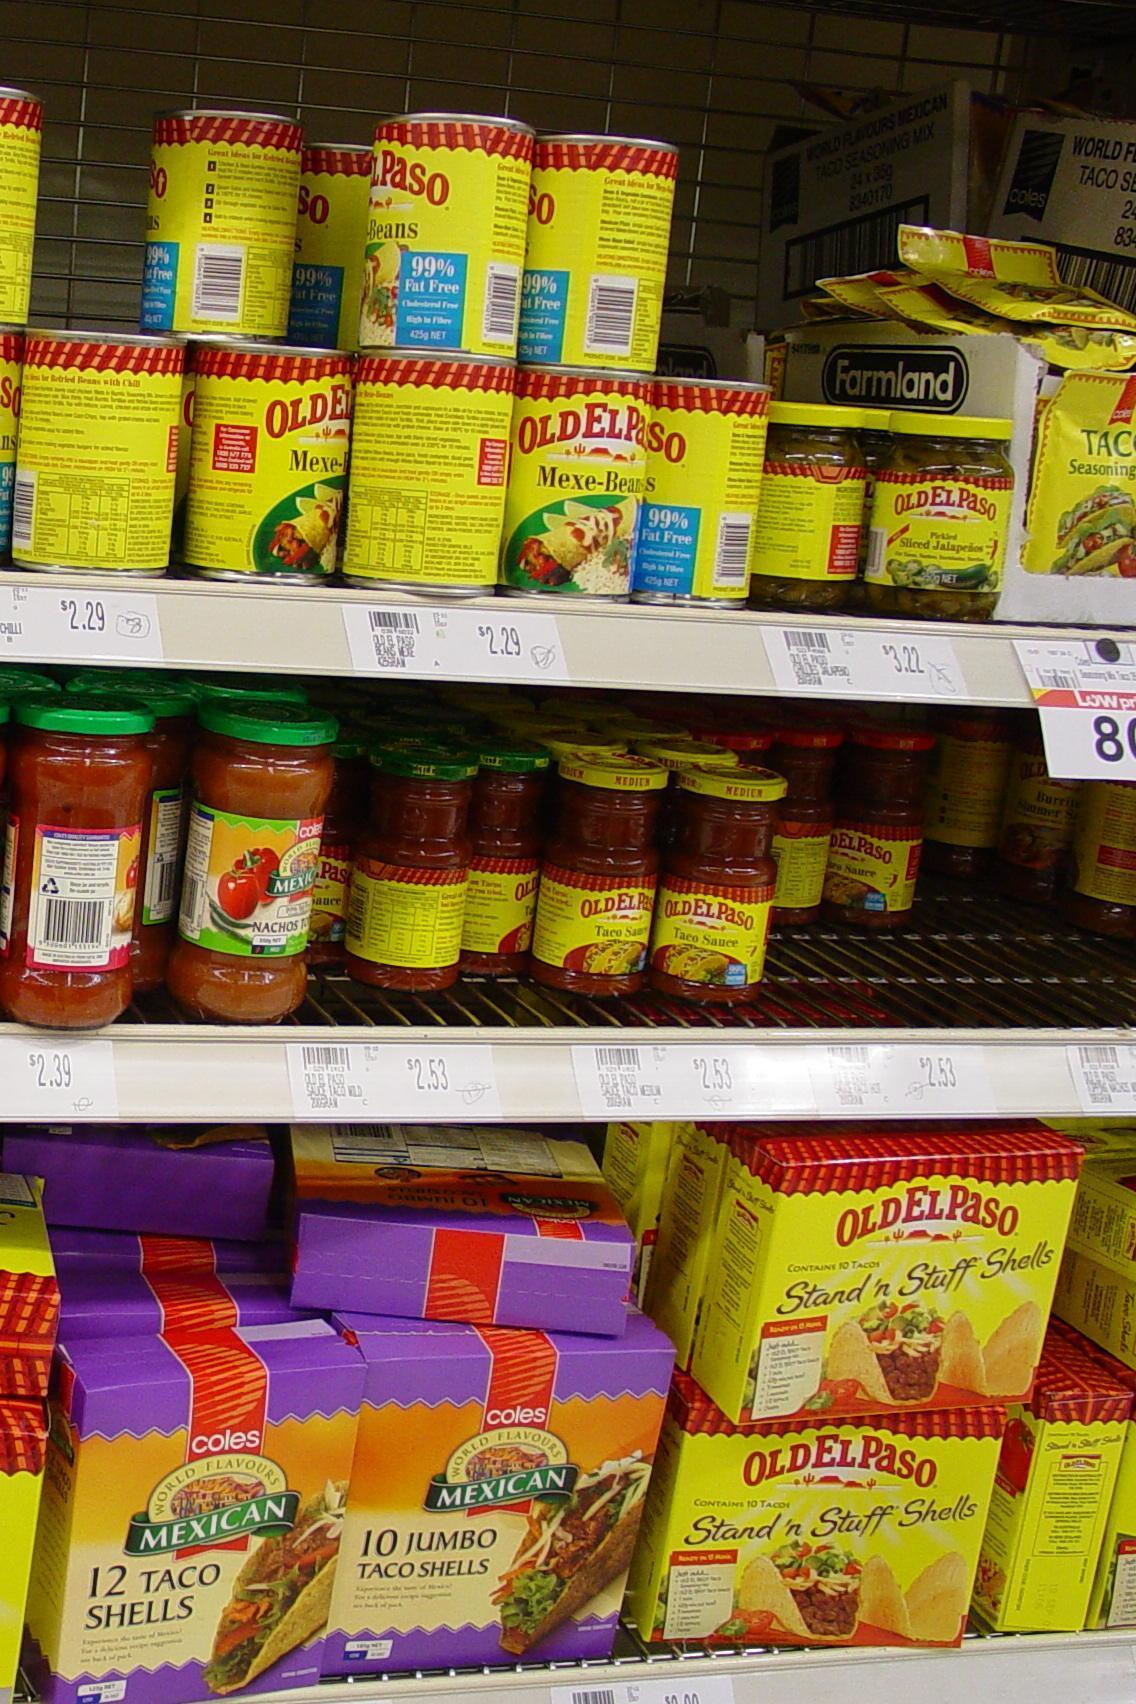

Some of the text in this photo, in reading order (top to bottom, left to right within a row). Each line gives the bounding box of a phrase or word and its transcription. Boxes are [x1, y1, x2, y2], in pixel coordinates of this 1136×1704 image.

[913, 121, 936, 145] MIX
[1072, 135, 1123, 161] WORLD
[1079, 165, 1119, 189] TACO
[411, 255, 455, 278] 99%
[405, 278, 460, 295] Fat Free
[524, 273, 557, 295] 99%
[533, 297, 561, 311] Free
[430, 331, 446, 341] NET
[835, 361, 955, 402] Farmland
[265, 392, 328, 439] OLD
[518, 410, 582, 454] OLD
[1080, 428, 1136, 457] TAC
[1068, 458, 1136, 481] Seasoning
[648, 508, 689, 530] 99%
[641, 530, 693, 547] Fat Free
[898, 537, 930, 550] Sliced
[0, 623, 22, 635] CHILLI
[61, 600, 106, 632] $2.29
[478, 625, 522, 657] $2.29
[882, 644, 925, 675] $3.22
[615, 775, 651, 788] MEDIUM
[725, 784, 764, 799] MEDIUM
[253, 920, 299, 934] NACHOS
[594, 925, 623, 938] Taco
[672, 926, 739, 949] Taco Sauce
[29, 1053, 73, 1088] $2.39
[407, 1058, 449, 1092] $2.53
[693, 1058, 733, 1090] $2.53
[919, 1057, 957, 1088] $2.53
[835, 1201, 902, 1249] OLD
[901, 1184, 947, 1225] EL
[775, 1274, 869, 1316] Stand
[897, 1257, 978, 1299] Stuff
[980, 1240, 1056, 1281] Shells
[851, 1259, 881, 1271] TACOS
[485, 1405, 547, 1426] coles
[191, 1429, 261, 1455] coles
[450, 1430, 563, 1479] WORLD FLAVOURS
[742, 1445, 812, 1489] OLD
[811, 1433, 860, 1469] EL
[154, 1457, 281, 1516] WORLD FLAVOURS
[435, 1468, 568, 1509] MEXICAN
[759, 1499, 791, 1510] TACOS
[139, 1497, 286, 1551] MEXICAN
[683, 1513, 782, 1546] Stand
[810, 1502, 898, 1537] Stuff
[898, 1493, 979, 1530] Shells
[361, 1527, 498, 1558] 10 JUMBO
[88, 1563, 222, 1599] 12 TACO
[357, 1557, 490, 1580] TACO SHELLS
[84, 1595, 195, 1631] SHELLS
